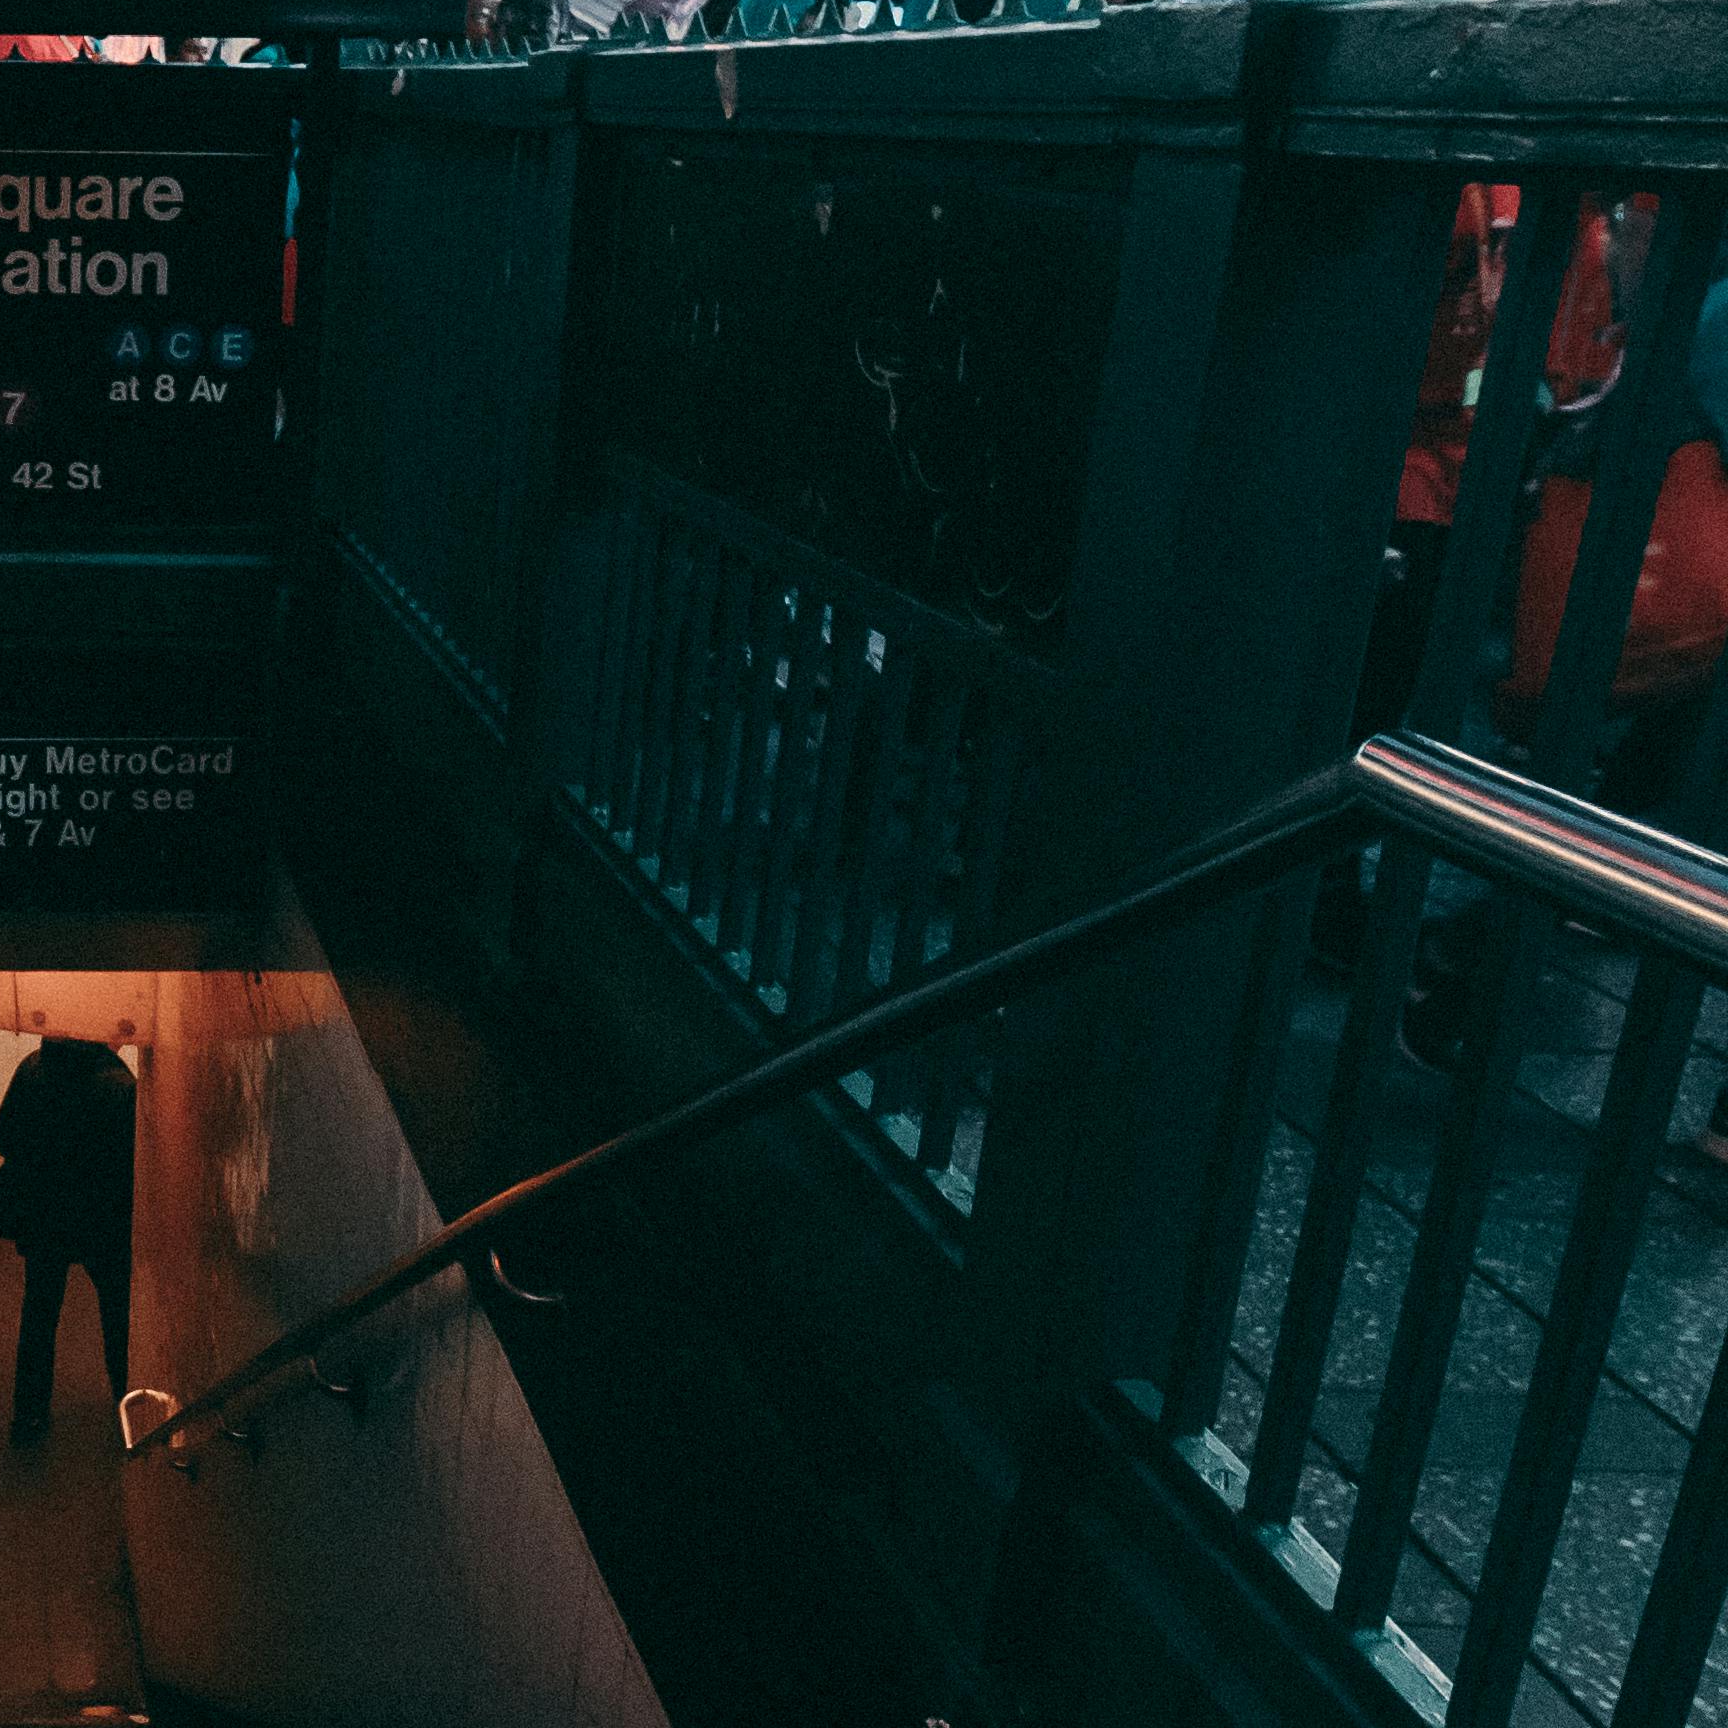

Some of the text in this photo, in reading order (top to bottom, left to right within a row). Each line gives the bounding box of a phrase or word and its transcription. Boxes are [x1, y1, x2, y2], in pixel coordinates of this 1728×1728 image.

[117, 330, 244, 362] A C E
[109, 375, 228, 404] at 8 Av
[2, 391, 26, 425] 7
[11, 461, 54, 489] 42
[66, 461, 103, 490] St
[44, 745, 234, 776] MetroCard
[79, 789, 114, 812] or
[133, 789, 195, 811] see
[24, 819, 42, 847] 7
[57, 818, 98, 847] Av
